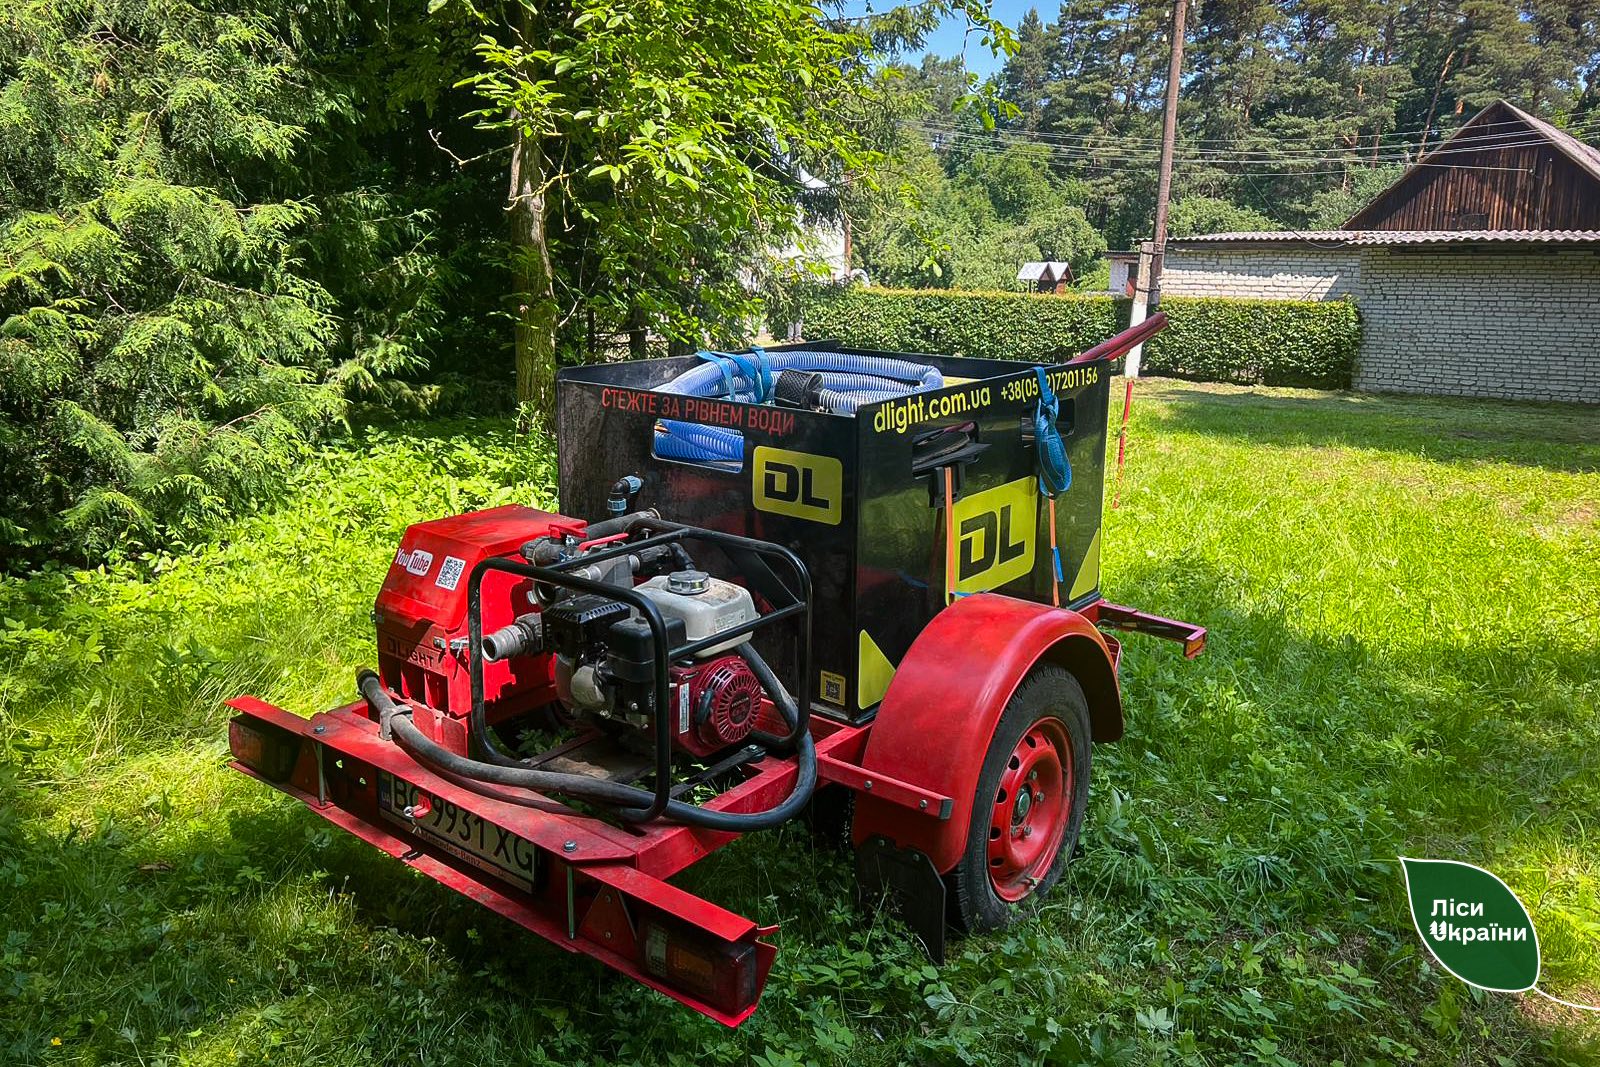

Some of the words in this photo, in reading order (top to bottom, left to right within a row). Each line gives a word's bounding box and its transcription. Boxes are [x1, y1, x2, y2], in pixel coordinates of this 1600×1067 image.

[602, 388, 657, 414] СТЕЖТЕ
[661, 397, 681, 417] ЗА
[685, 400, 743, 426] РІВНЕМ
[748, 408, 795, 436] ВОДИ
[874, 387, 991, 433] dlight.com.ua
[764, 461, 830, 510] DL
[395, 548, 429, 572] YouTube
[959, 504, 1026, 582] DL
[432, 797, 485, 850] 9931
